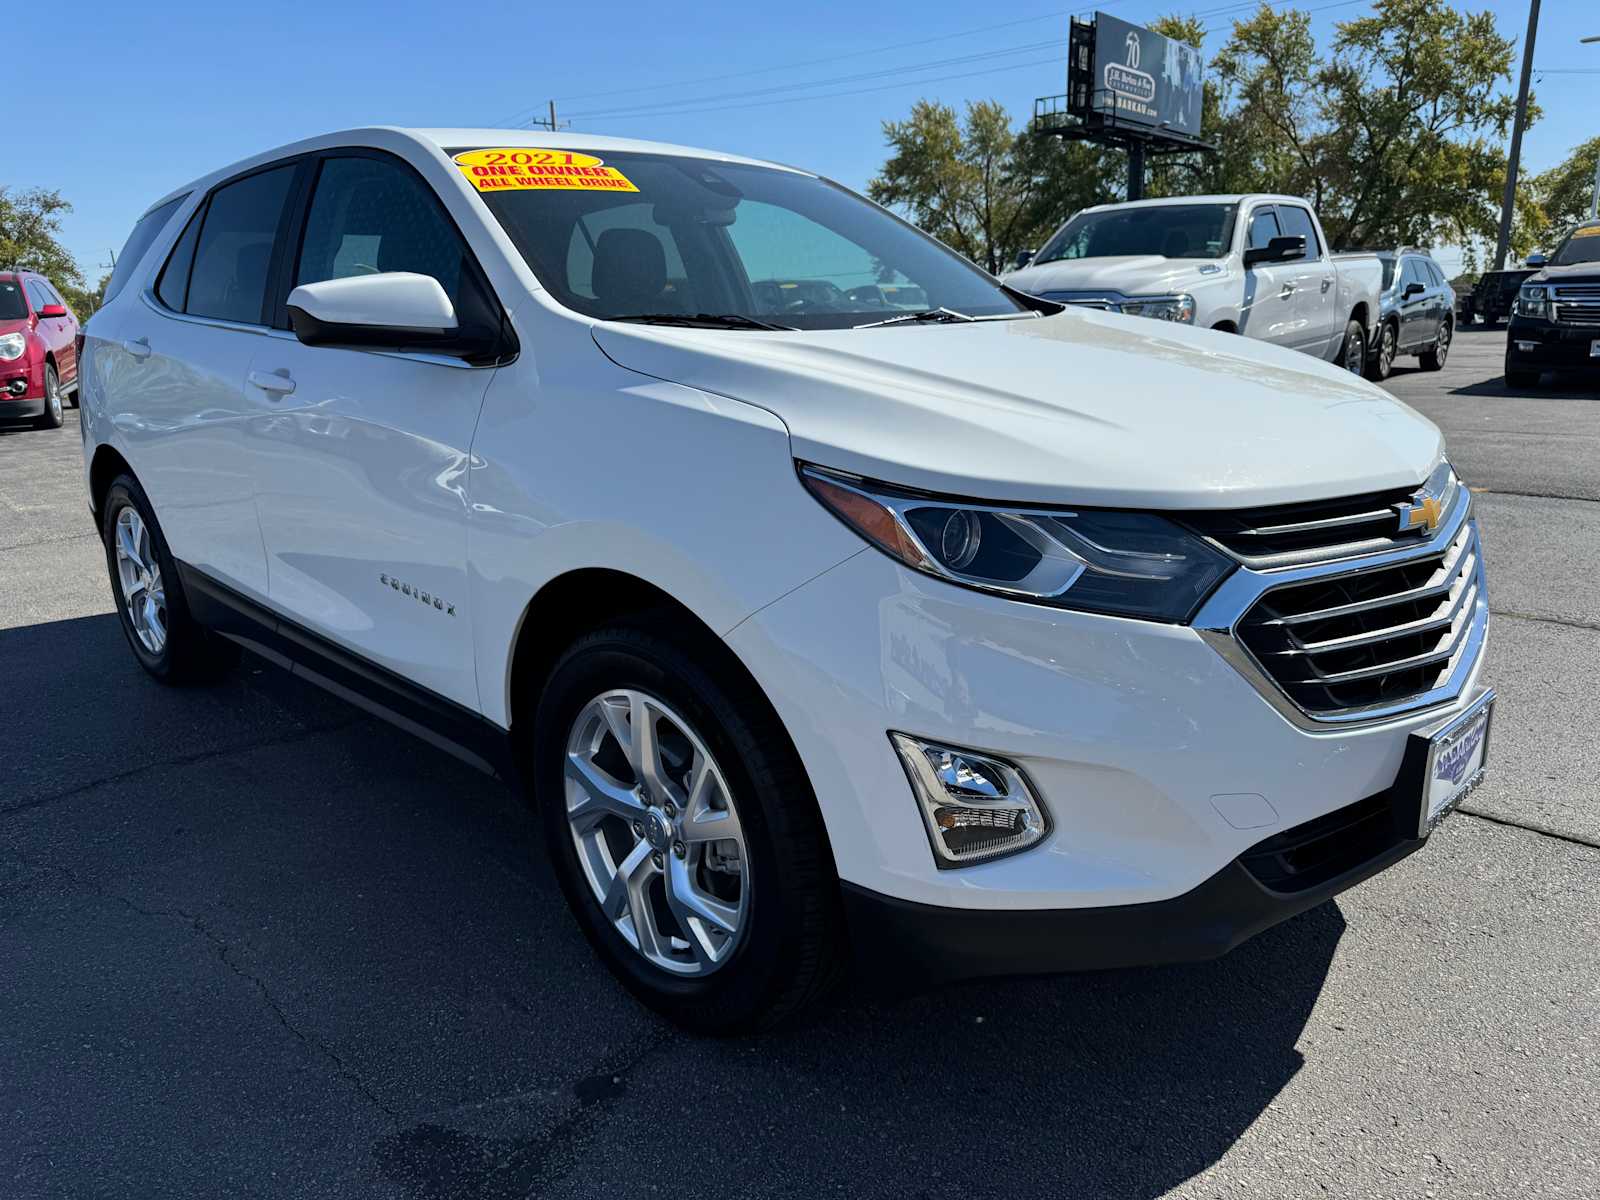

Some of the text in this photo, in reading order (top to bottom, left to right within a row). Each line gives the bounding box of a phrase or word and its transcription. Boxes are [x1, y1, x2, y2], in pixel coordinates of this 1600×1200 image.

[484, 153, 575, 165] 2021
[472, 166, 610, 177] ONE OWNER
[479, 177, 631, 189] ALL WHEEL DRIVE
[380, 573, 456, 616] EQUINOX
